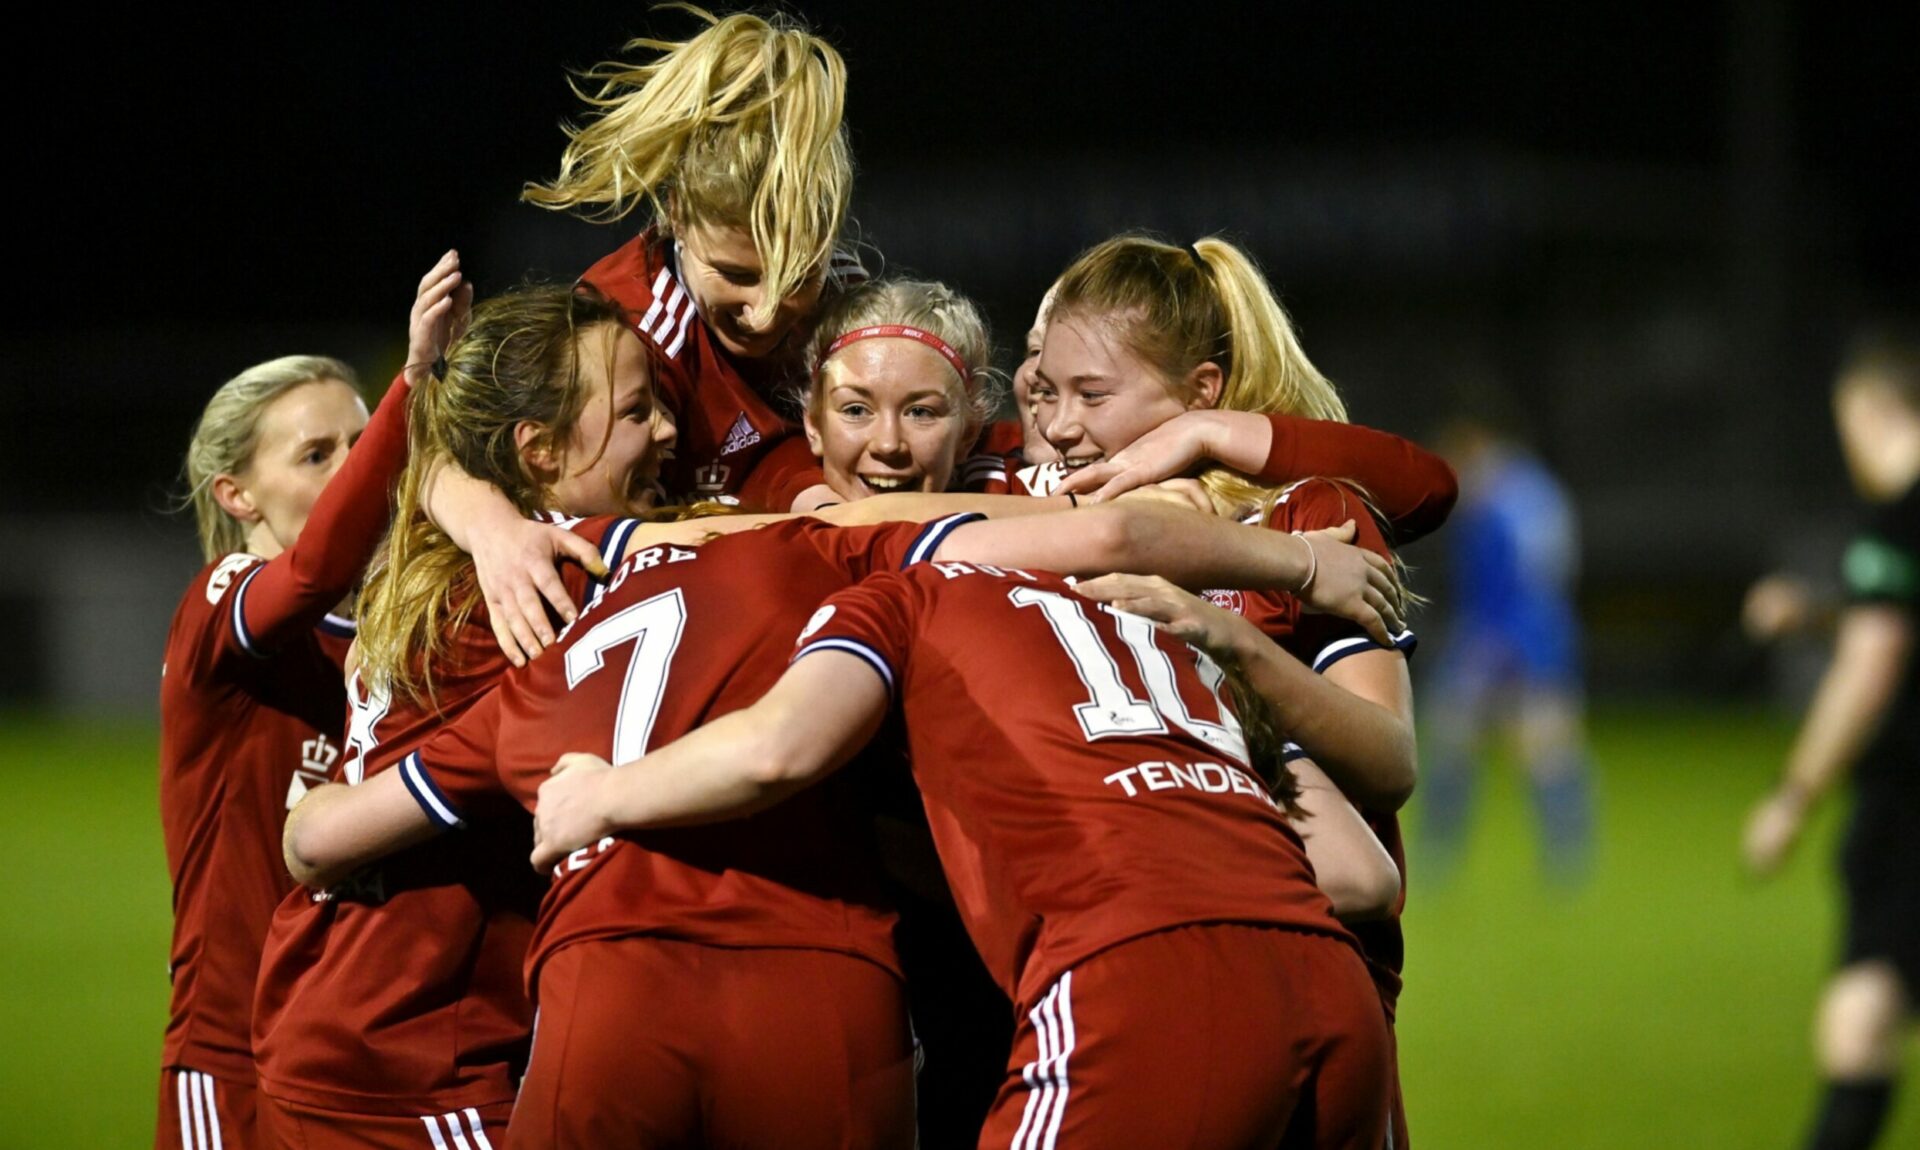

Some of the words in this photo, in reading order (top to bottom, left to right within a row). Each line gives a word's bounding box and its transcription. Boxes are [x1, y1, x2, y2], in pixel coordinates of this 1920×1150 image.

[720, 432, 761, 456] adidas
[564, 587, 687, 768] 7
[1007, 585, 1253, 768] 10
